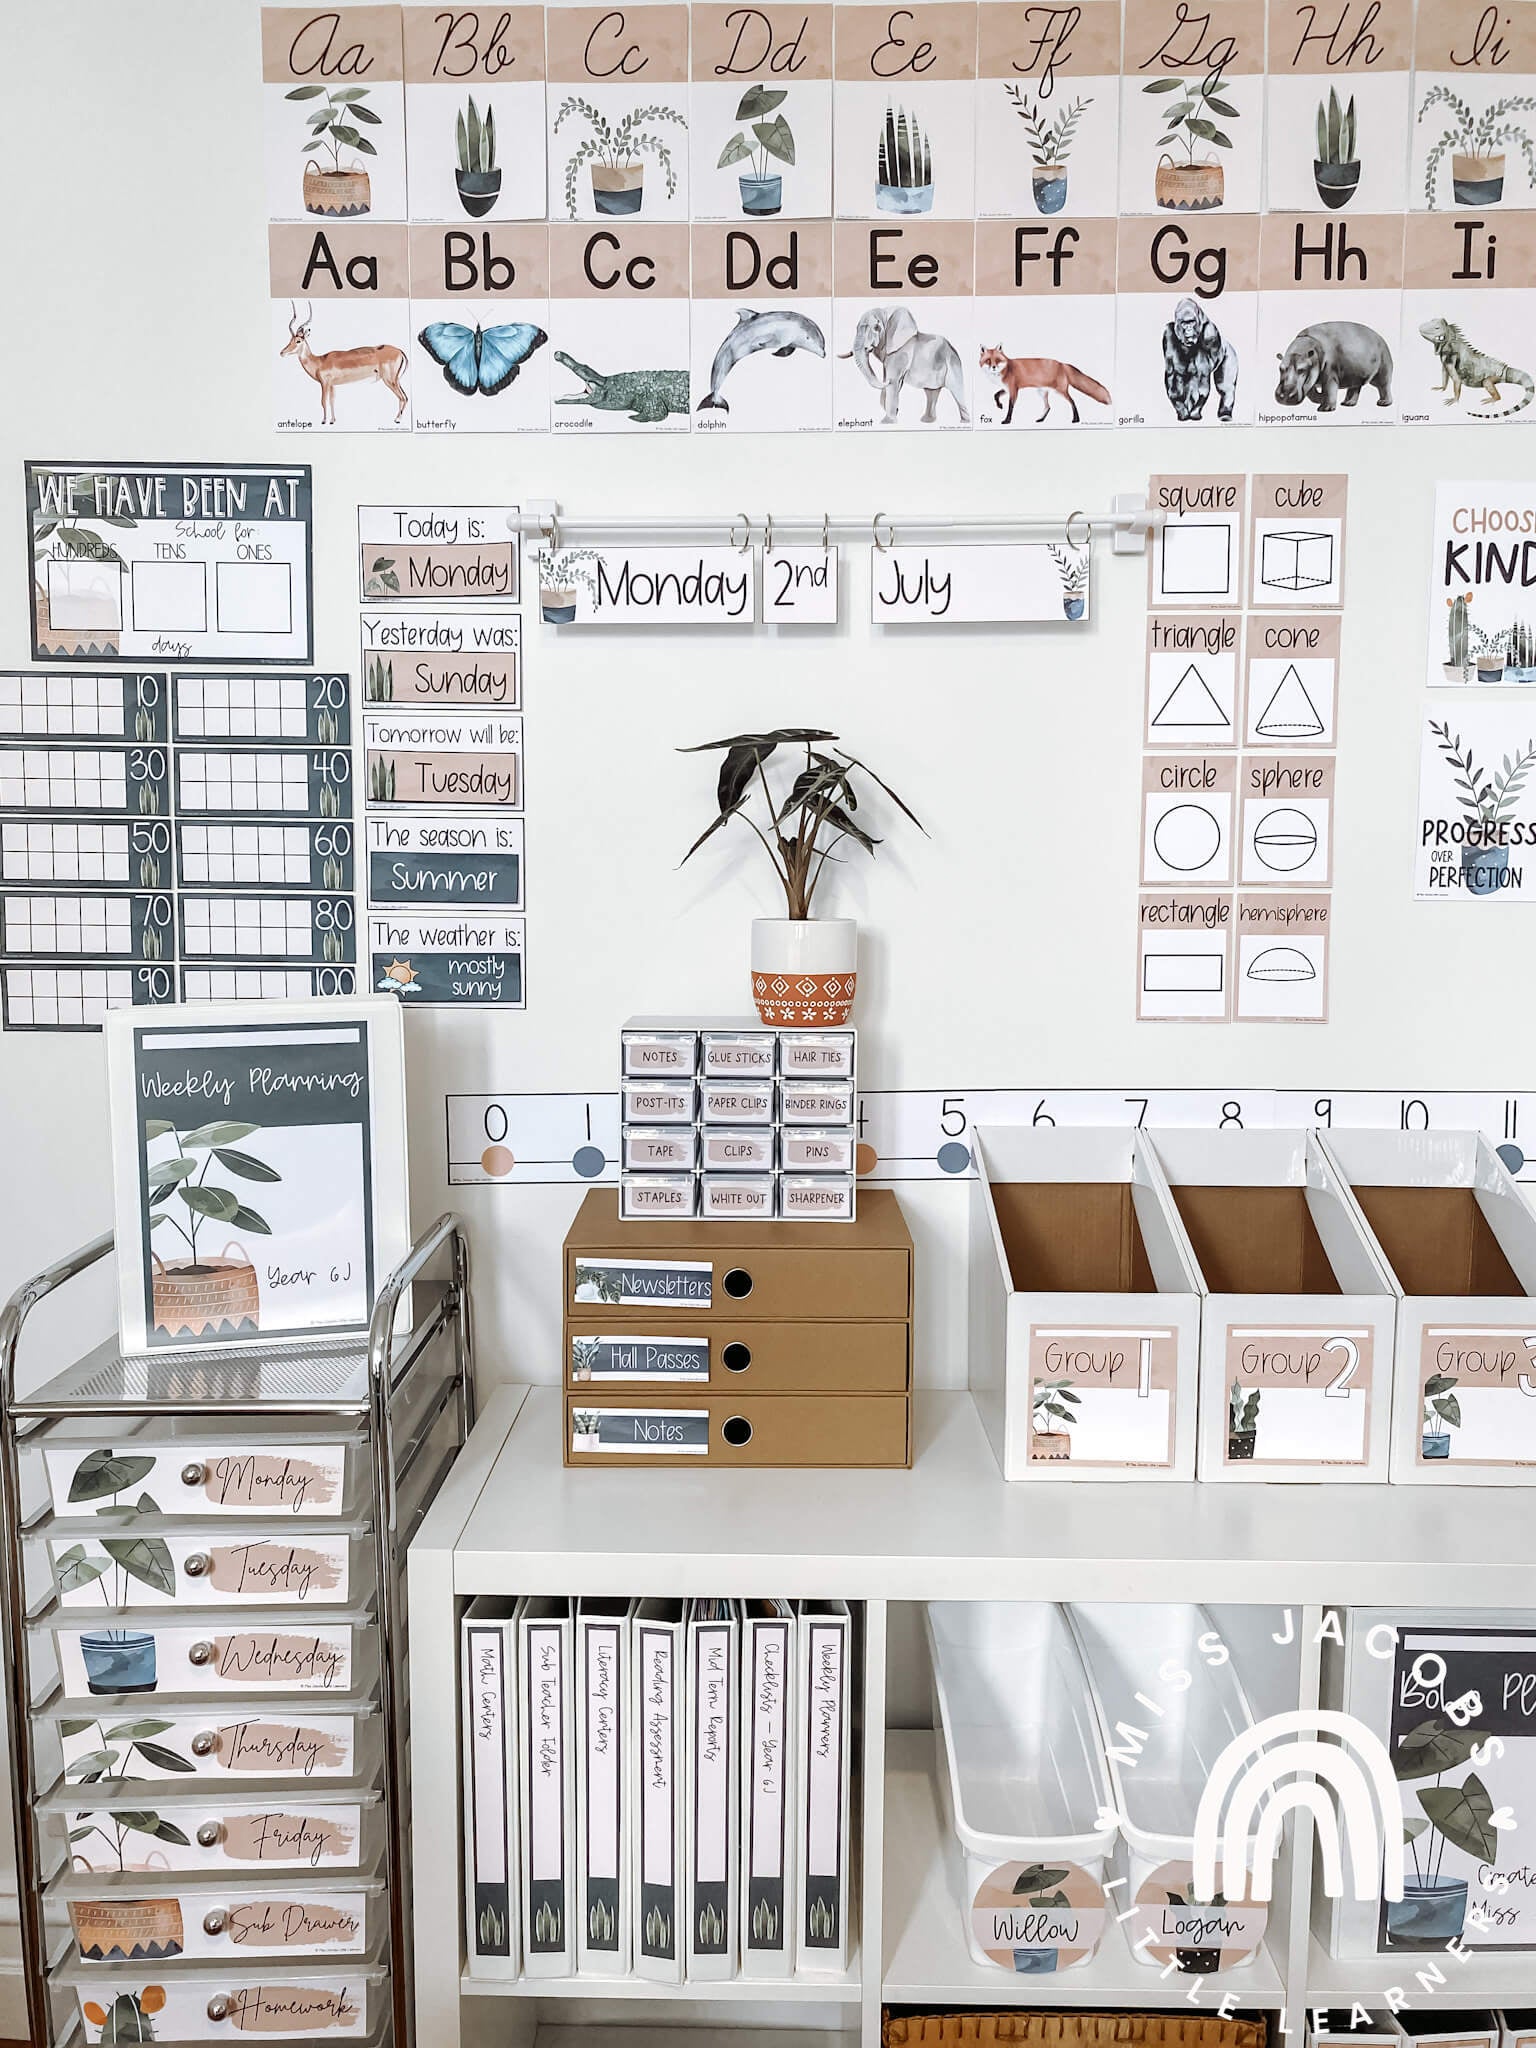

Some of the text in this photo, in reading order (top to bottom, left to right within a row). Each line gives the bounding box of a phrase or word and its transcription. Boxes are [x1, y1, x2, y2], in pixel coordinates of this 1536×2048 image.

[289, 13, 374, 77] Aa
[433, 11, 516, 78] Bb
[584, 11, 649, 78] Cc
[714, 11, 809, 76] Dd
[871, 11, 936, 77] Ee
[1138, 2, 1239, 96] Gg
[1292, 3, 1385, 68] Hh
[1450, 4, 1511, 68] Ii
[1011, 6, 1082, 99] Ff
[301, 231, 378, 290] Aa
[445, 231, 516, 291] Bb
[584, 231, 656, 290] Cc
[727, 231, 799, 291] Dd
[871, 229, 938, 289] Ee
[1015, 226, 1080, 287] Ff
[1150, 224, 1227, 299] Gg
[1294, 222, 1367, 281] Hh
[1451, 221, 1496, 280] Ii
[276, 419, 313, 430] antelope
[416, 419, 457, 430] butterfly
[554, 418, 594, 428] crocodile
[698, 419, 727, 429] dolphin
[838, 417, 874, 428] elephant
[979, 414, 993, 423] fox
[1118, 413, 1145, 424] gorilla
[1258, 412, 1318, 423] hippopotamus
[1402, 411, 1430, 422] iguana
[37, 475, 300, 518] WE HAVE BEEN AT
[1158, 486, 1237, 517] square
[1275, 480, 1323, 507] cube
[175, 521, 226, 540] School
[393, 512, 485, 544] Today is:
[51, 541, 272, 561] HUNDREDS TENS ONES
[409, 555, 508, 592] Monday
[597, 558, 749, 616] Monday
[773, 557, 829, 607] 2nd
[879, 559, 952, 615] July
[151, 635, 193, 658] days
[363, 619, 519, 653] Yesterday was:
[1151, 618, 1236, 655] triangle
[1265, 627, 1320, 648] cone
[136, 675, 159, 708] 10
[312, 676, 346, 709] 20
[415, 663, 507, 701] Sunday
[367, 722, 519, 744] Tomorrow will be:
[130, 749, 166, 781] 30
[313, 751, 349, 784] 40
[1160, 759, 1217, 788] circle
[1250, 761, 1323, 796] sphere
[414, 762, 511, 801] Tuesday
[132, 822, 170, 854] 50
[314, 824, 351, 856] 60
[370, 821, 513, 848] The season is:
[1422, 819, 1536, 846] PROGRESS
[1431, 850, 1454, 863] OVER
[391, 862, 498, 892] Summer
[1429, 866, 1523, 889] PERFECTION
[135, 895, 172, 926] 70
[314, 899, 353, 930] 80
[1140, 898, 1230, 928] rectangle
[1239, 903, 1328, 926] hemisphere
[373, 922, 521, 947] The weather is:
[137, 967, 170, 998] 90
[315, 967, 356, 997] 100
[448, 954, 505, 979] mostly
[451, 980, 502, 1000] sunny
[642, 1051, 678, 1062] NOTES
[707, 1051, 771, 1064] GLUE STICKS
[793, 1051, 841, 1063] HAIR TIES
[141, 1067, 364, 1106] Weekly Planning
[636, 1097, 685, 1108] POST-ITS
[708, 1096, 768, 1109] PAPER CLIPS
[484, 1103, 509, 1142] 0
[940, 1098, 966, 1137] 5
[1124, 1098, 1148, 1128] 7
[1219, 1101, 1244, 1129] 8
[1315, 1099, 1331, 1129] 9
[1401, 1099, 1429, 1130] 10
[785, 1099, 847, 1110] BINDER RINGS
[648, 1145, 673, 1157] TAPE
[724, 1145, 752, 1156] CLIPS
[806, 1146, 829, 1157] PINS
[636, 1192, 682, 1203] STAPLES
[711, 1192, 767, 1204] WHITE OUT
[789, 1192, 845, 1204] SHARPENER
[267, 1264, 317, 1289] Year
[621, 1272, 712, 1297] Newsletters
[610, 1345, 700, 1369] Hall Passes
[1045, 1342, 1124, 1383] Group
[1241, 1336, 1359, 1398] Group 2
[1436, 1341, 1516, 1383] Group
[633, 1418, 684, 1441] Notes
[216, 1455, 314, 1513] Monday
[231, 1539, 319, 1600] Tuesday
[220, 1635, 344, 1687] Wednesday
[478, 1648, 497, 1740] Math Centers
[592, 1645, 614, 1755] Literacy Centers
[704, 1647, 724, 1762] Mid Term Reports
[759, 1643, 780, 1772] Checklists Year
[815, 1644, 837, 1758] Weekly Planners
[539, 1645, 557, 1777] Sub Teacher Folder
[648, 1650, 669, 1789] Reading Assessment
[220, 1718, 325, 1776] Thursday
[250, 1812, 330, 1866] Friday
[229, 1904, 359, 1943] Sub Drawer
[993, 1912, 1079, 1942] Willow
[1162, 1909, 1245, 1944] Logan
[229, 1985, 353, 2030] Homework
